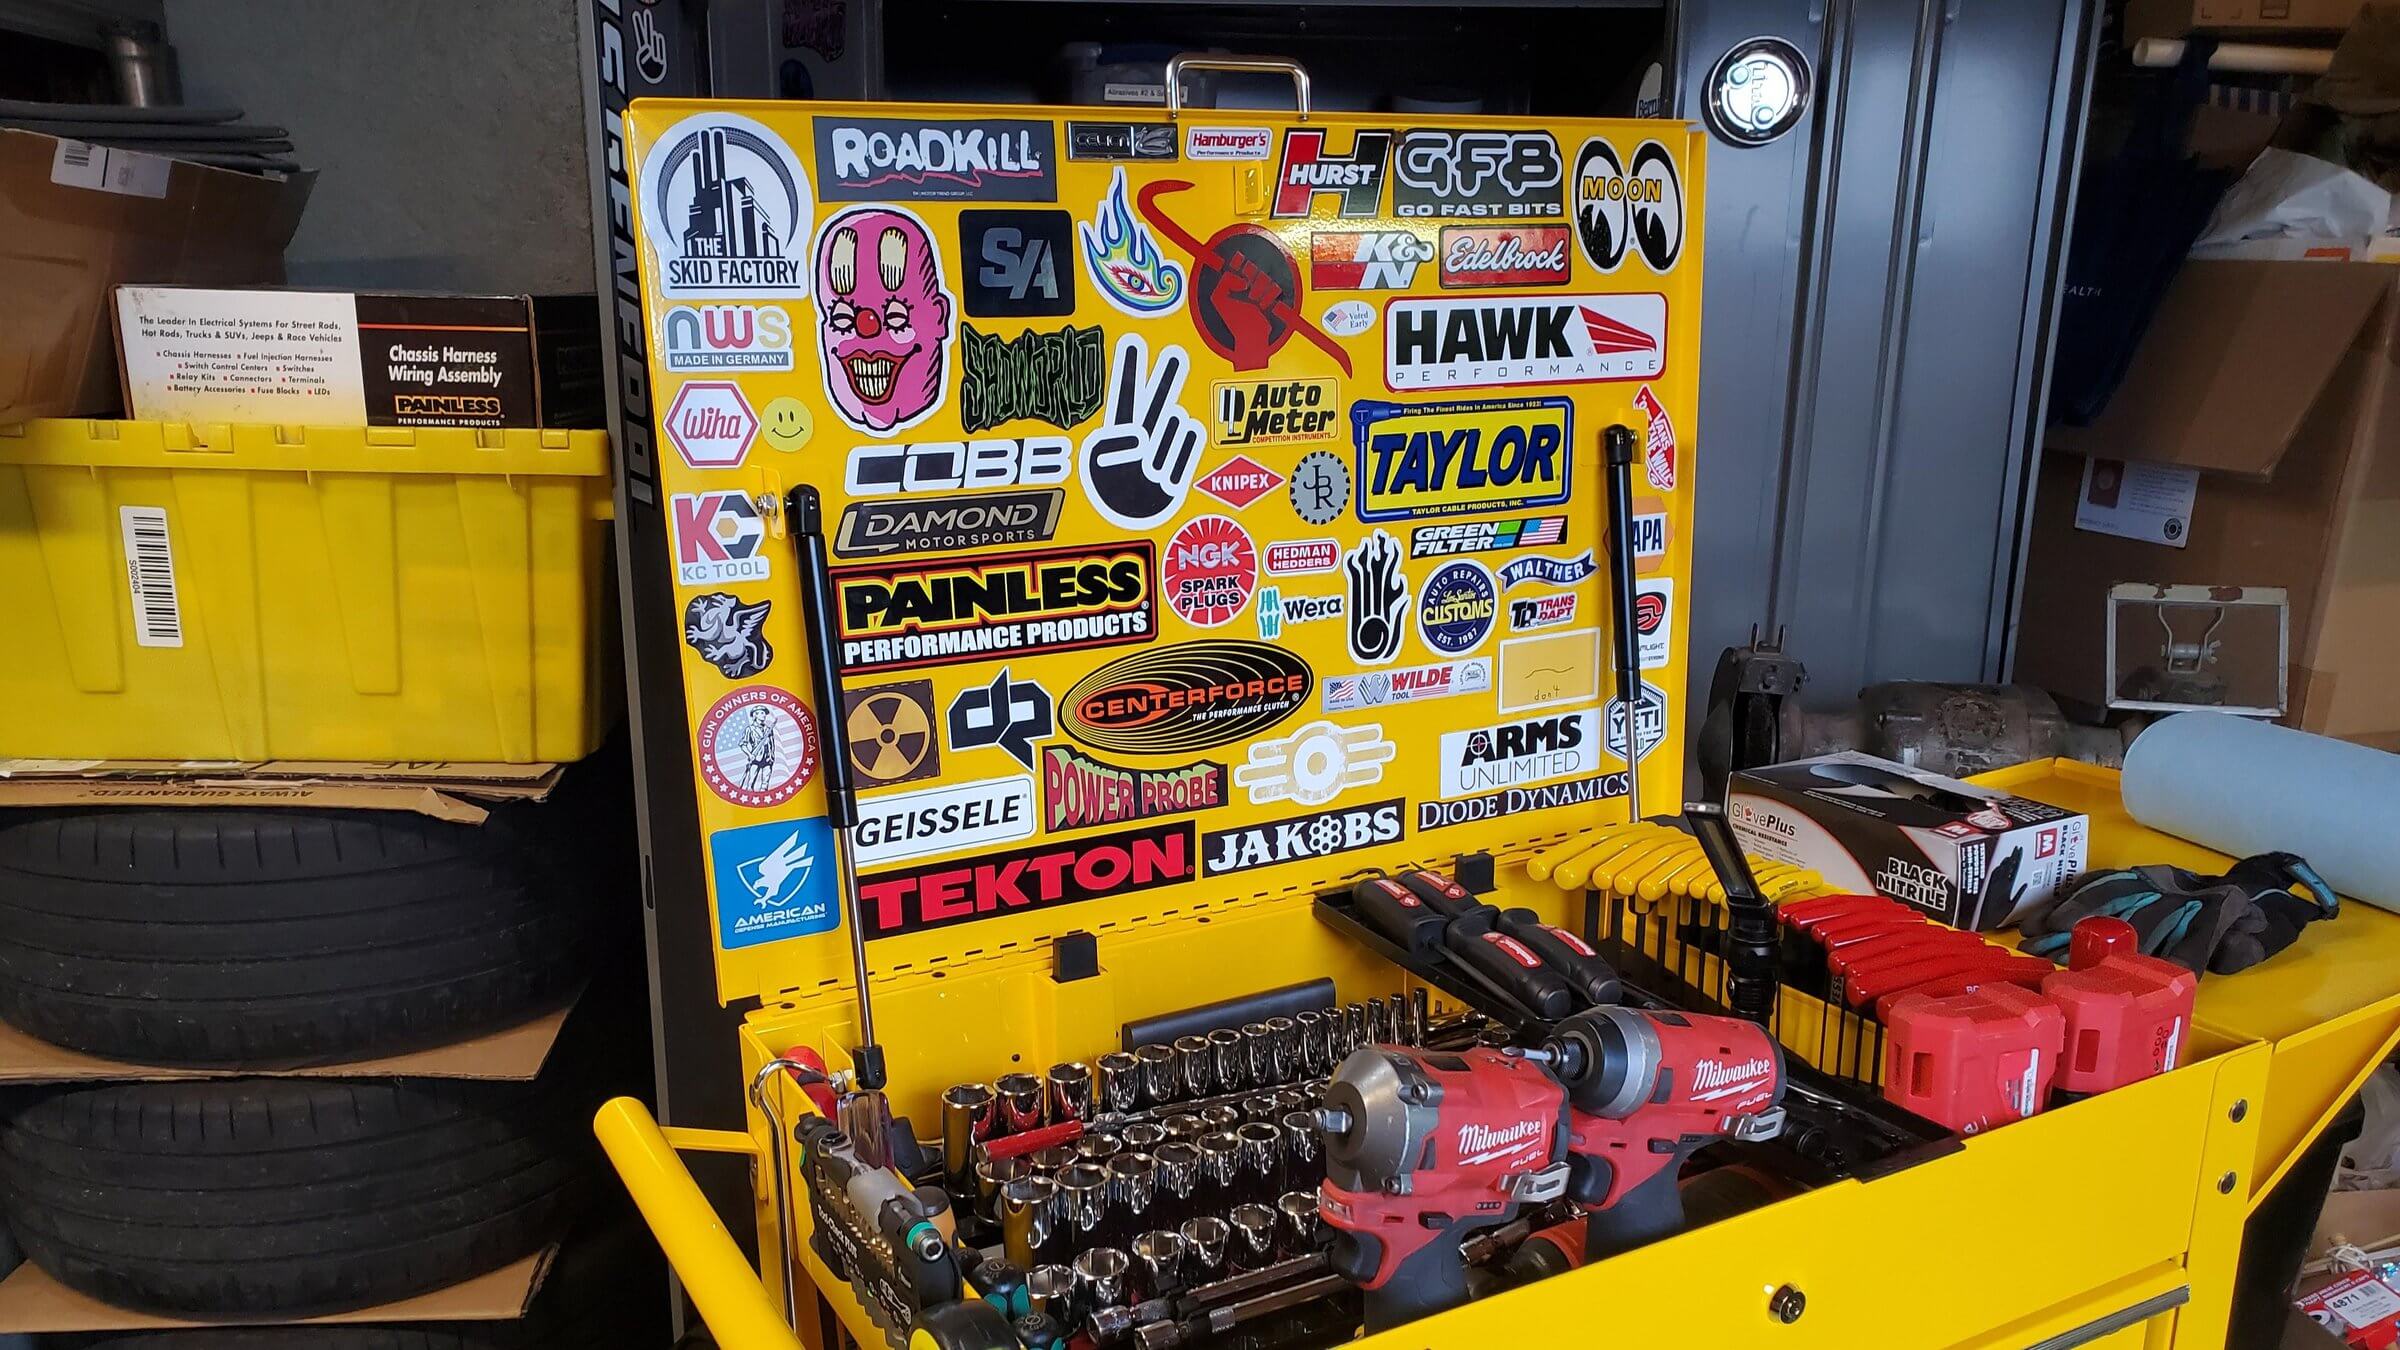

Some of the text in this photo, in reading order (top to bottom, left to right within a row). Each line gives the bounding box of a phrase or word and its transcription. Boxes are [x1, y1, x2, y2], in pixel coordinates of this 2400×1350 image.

[1192, 132, 1267, 149] Hamburger's
[1289, 163, 1376, 186] HURST
[1395, 131, 1563, 198] GFB
[1582, 175, 1663, 202] MOON
[1397, 202, 1561, 216] GO FAST BITS
[695, 237, 722, 256] THE
[1445, 234, 1566, 274] Edelbrock
[669, 259, 799, 284] SKID FACTORY
[139, 316, 342, 331] The Leader In Electrical Systems For Street Rods,
[1349, 310, 1369, 320] Voted
[1350, 320, 1369, 329] Early
[141, 329, 342, 343] Hot Rods, Trucks & SUVs, Jeeps & Race Vehicles
[1394, 305, 1576, 366] HAWK
[162, 350, 333, 363] Chassis Harnesses Fuel Injection Harnesses
[389, 344, 497, 364] Chassis Harness
[673, 353, 784, 366] MADE IN GERMANY
[176, 372, 325, 384] Relay Kits Connectors Terminals
[184, 361, 315, 373] Switch Control Centers Switches
[388, 364, 502, 388] Wiring Assembly
[1394, 358, 1657, 383] PERFORMANCE
[173, 384, 331, 397] Battery Accessories Fuse Blocks LEDs
[1250, 381, 1322, 410] Auto
[395, 395, 501, 416] PAINLESS
[1403, 406, 1422, 415] Firing
[1423, 406, 1435, 414] The
[1436, 404, 1455, 413] Finest
[1456, 403, 1474, 412] Rides
[1482, 401, 1507, 411] America
[1508, 401, 1524, 409] Since
[398, 417, 500, 427] PERFORMANCE PRODUCTS
[683, 406, 742, 443] Wiha
[1244, 408, 1336, 440] Meter
[1252, 431, 1331, 443] COMPETITION INSTRUMENTS
[845, 437, 1073, 494] COBB
[1369, 423, 1562, 496] TAYLOR
[1210, 472, 1269, 491] KNIPEX
[1412, 499, 1524, 515] TAYLOR CABLE PRODUCTS, INC.
[865, 502, 1039, 538] DAMOND
[1415, 522, 1500, 541] GREEN
[905, 529, 1036, 551] MOTORSPORTS
[1412, 536, 1495, 556] FILTER
[1633, 519, 1662, 553] APA
[1177, 540, 1242, 571] NGK
[1272, 557, 1331, 570] HEDDERS
[1273, 544, 1331, 559] HEDMAN
[128, 560, 141, 594] S002404
[682, 563, 765, 581] KC TOOL
[1510, 558, 1584, 581] WALTHER
[840, 556, 1147, 635] PAINLESS
[1181, 576, 1239, 594] SPARK
[1429, 570, 1489, 605] AUTO REPAIRS
[1181, 591, 1240, 610] PLUGS
[1283, 596, 1342, 620] Wera
[1422, 598, 1494, 626] CUSTOMS
[1537, 594, 1576, 610] TRANS
[1541, 607, 1574, 621] DAPT
[843, 611, 1147, 665] PERFORMANCE PRODUCTS
[1437, 627, 1478, 647] EST. 1987
[1391, 666, 1454, 692] WILDE
[1086, 675, 1304, 719] CENTERFORCE
[1391, 692, 1410, 701] TOOL
[702, 691, 816, 752] GUN OWNERS OF AMERICA
[1192, 700, 1290, 721] THE PERFORMANCE CLUTCH
[1461, 714, 1583, 767] ARMS
[1460, 751, 1581, 791] UNLIMITED
[88, 789, 314, 799] ALWAYS GUARANTEED.
[1047, 750, 1219, 830] POWER PROBE
[1420, 773, 1629, 830] DIODE DYNAMICS
[856, 795, 1020, 849] GEISSELE
[1732, 800, 1796, 837] GlovePlus
[1207, 804, 1401, 873] JAKOBS
[1732, 823, 1788, 848] CHEMICAL RESISTANCE
[2053, 824, 2068, 897] BLACK NITRILE
[860, 832, 1187, 932] TEKTON
[1887, 857, 1949, 890] BLACK
[1876, 870, 1948, 911] NITRILE
[734, 902, 826, 929] AMERICAN
[1693, 1056, 1772, 1092] Milwaukee
[1736, 1091, 1773, 1109] FUEL
[1457, 1119, 1543, 1155] Milwaukee
[1510, 1149, 1545, 1169] FUEL
[2332, 1293, 2361, 1310] 4871
